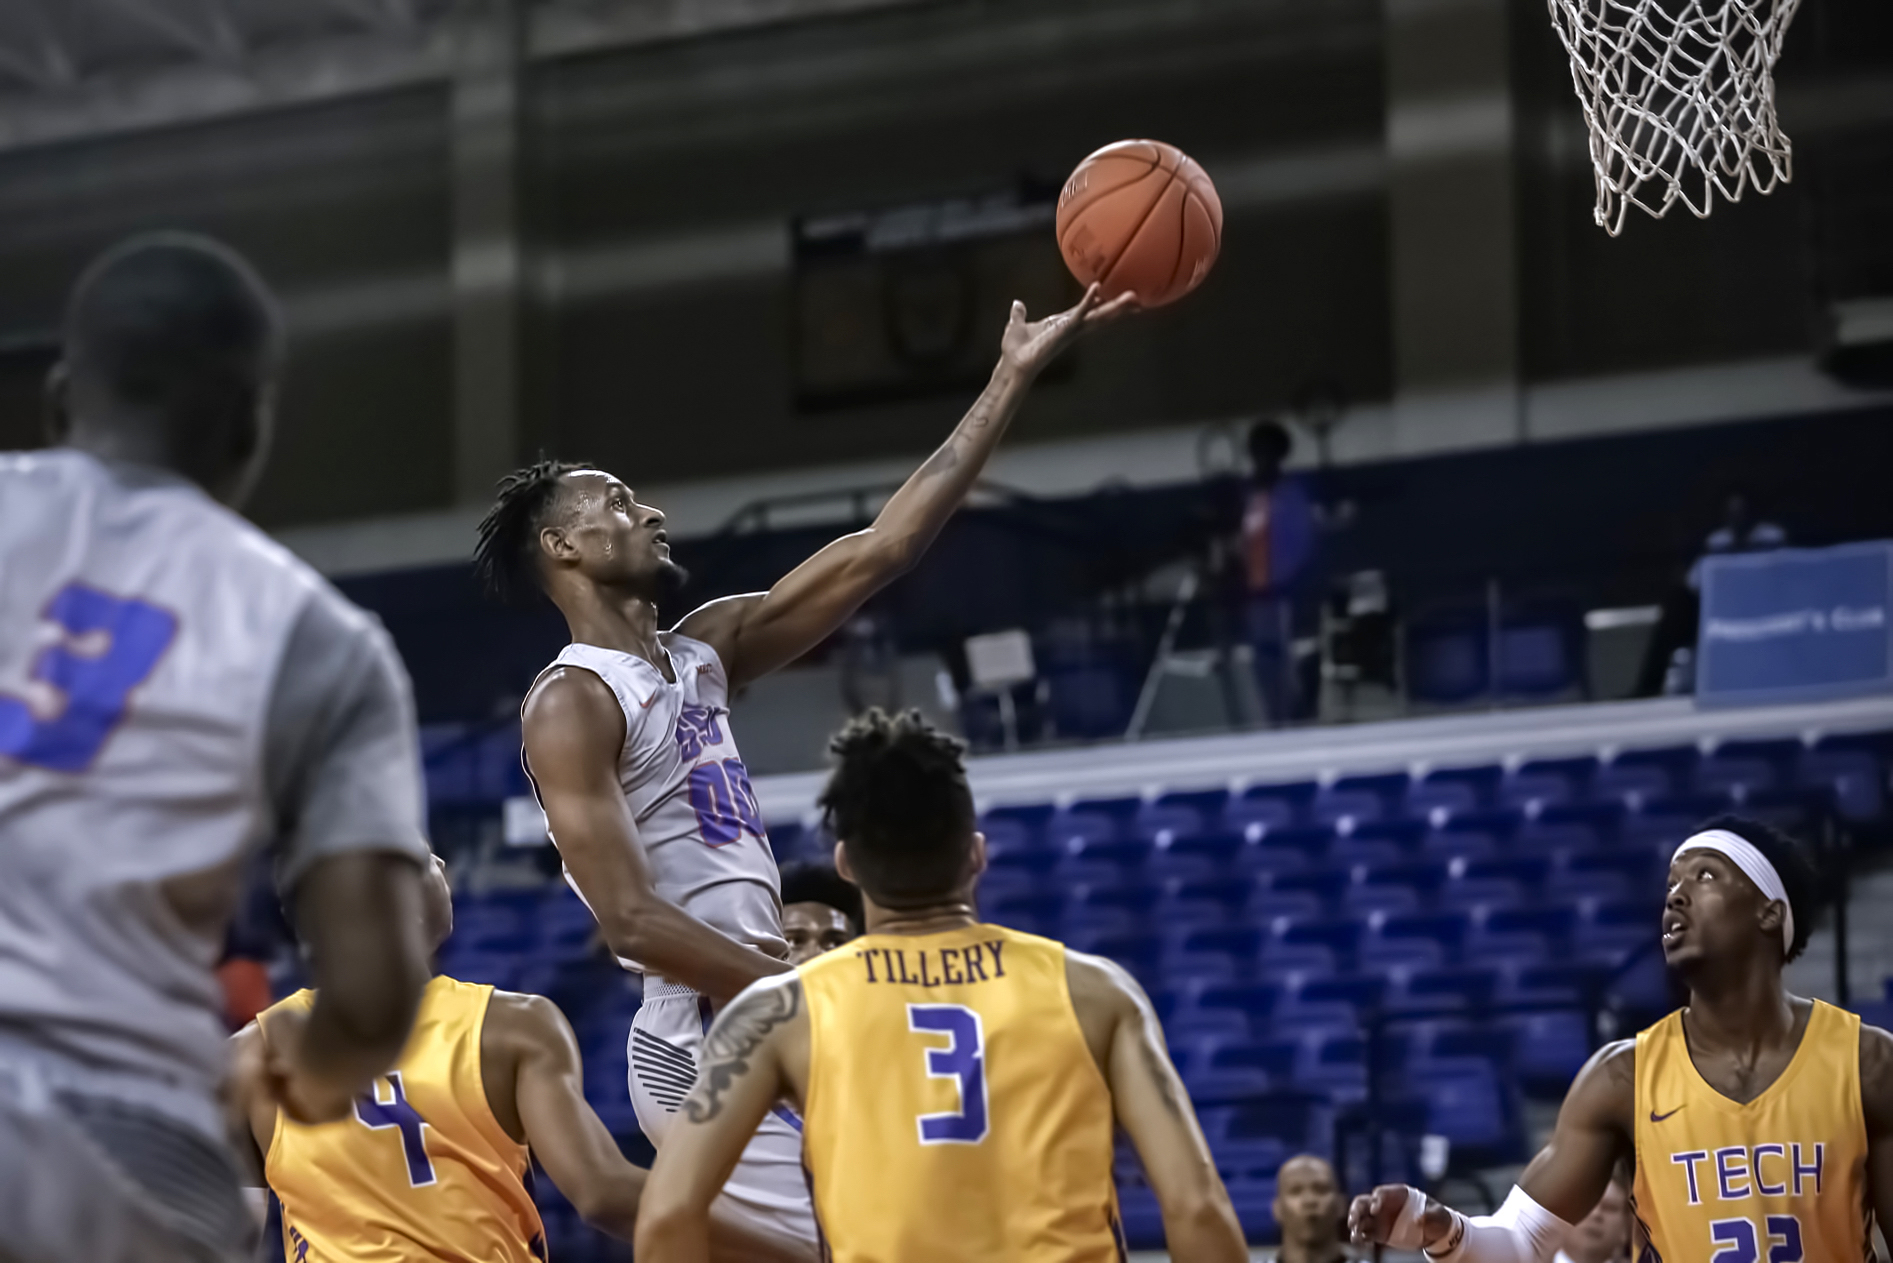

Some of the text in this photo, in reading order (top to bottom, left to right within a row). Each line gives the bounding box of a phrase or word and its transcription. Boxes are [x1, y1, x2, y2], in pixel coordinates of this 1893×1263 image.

[0, 574, 182, 775] 3
[688, 757, 766, 849] 00
[856, 940, 1006, 987] TILLERY
[906, 1003, 990, 1146] 3
[353, 1070, 437, 1188] 4
[1670, 1141, 1825, 1206] TECH
